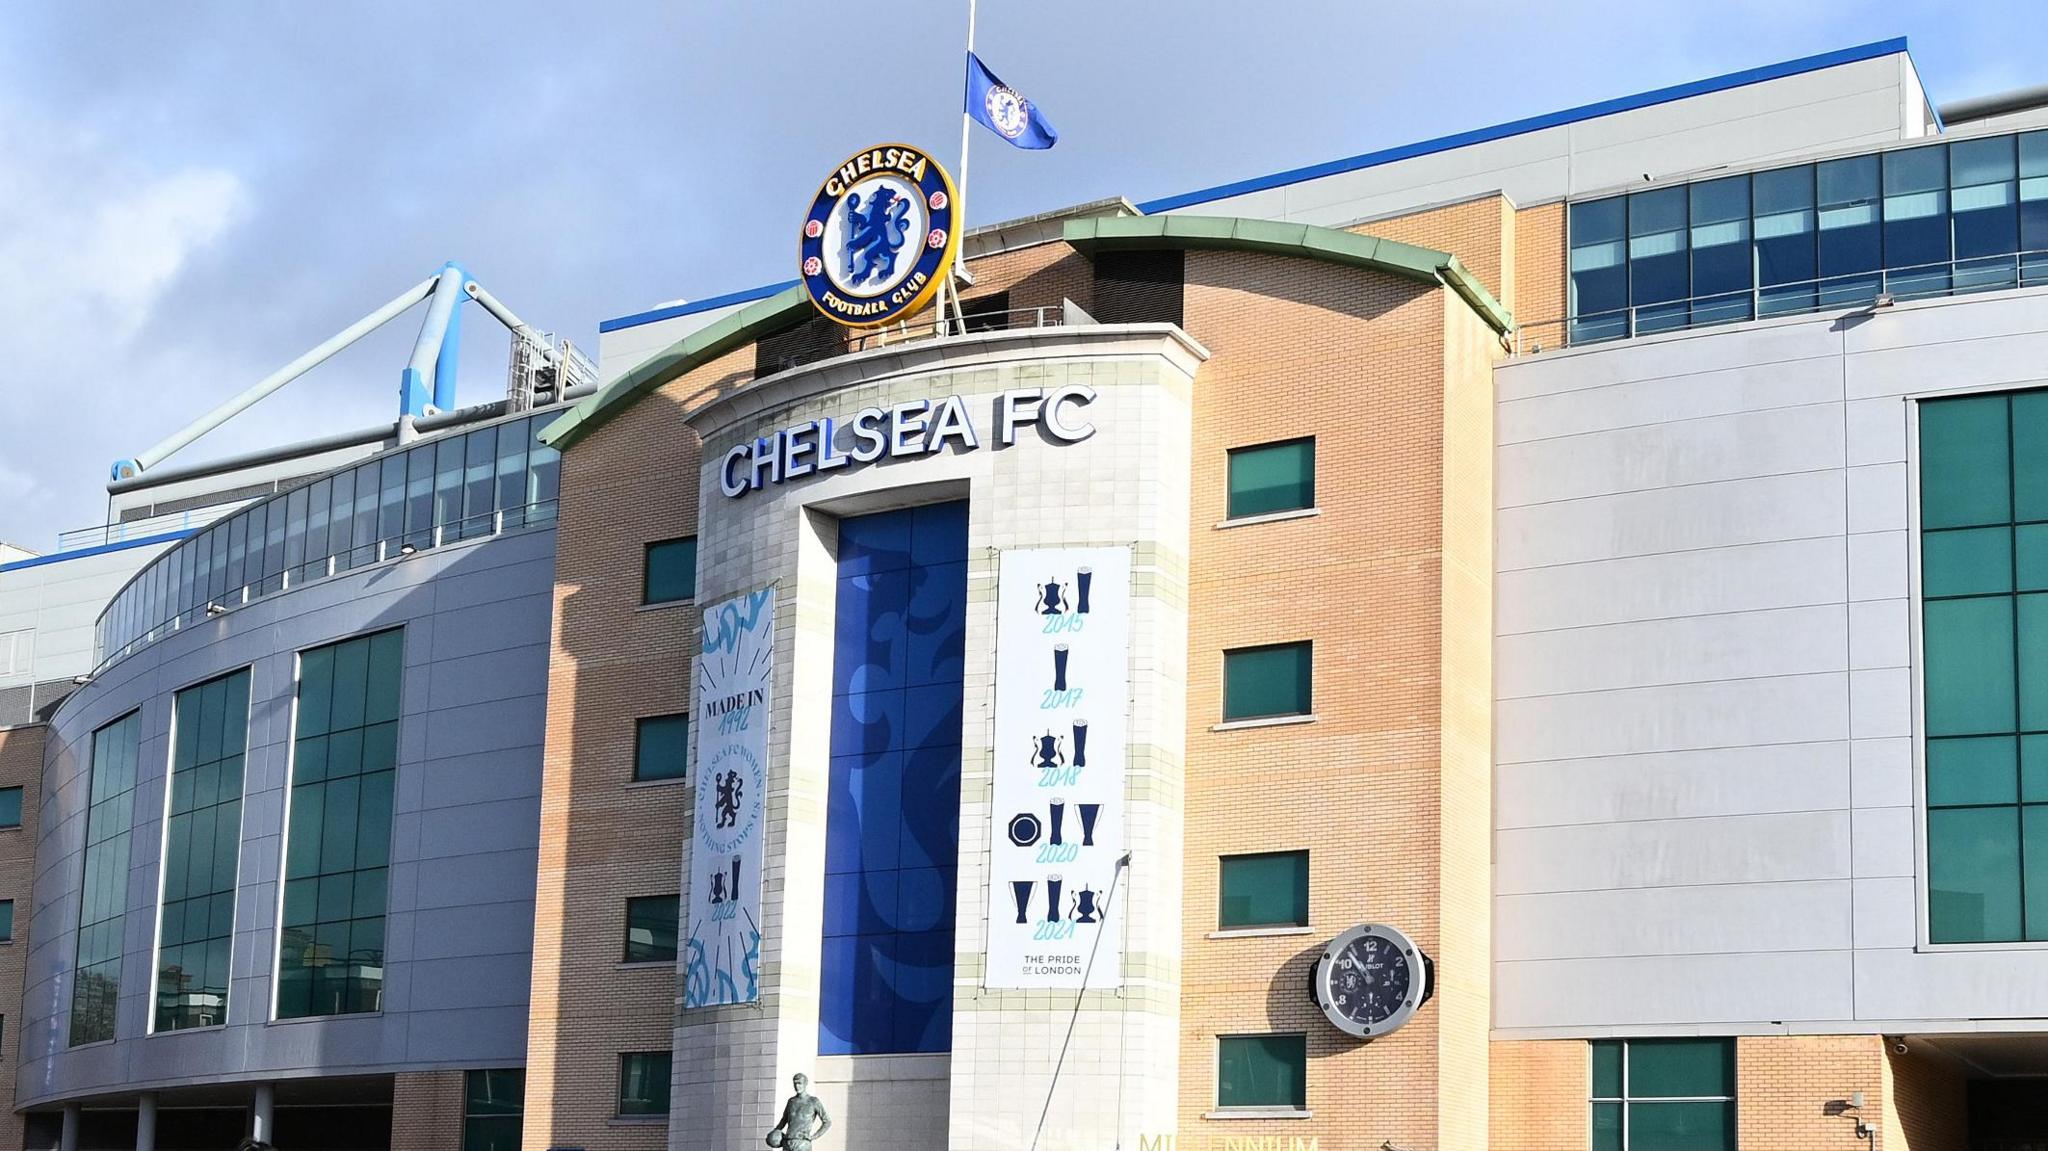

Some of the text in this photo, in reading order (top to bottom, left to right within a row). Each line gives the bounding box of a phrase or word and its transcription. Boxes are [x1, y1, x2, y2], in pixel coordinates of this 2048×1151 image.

[825, 147, 928, 197] CHELSEA
[822, 271, 928, 315] FOOTBALL CLUB
[720, 383, 1098, 498] CHELSEA FC
[1042, 612, 1084, 634] 2015
[705, 687, 765, 719] MADE IN
[1040, 688, 1084, 709] 2017
[718, 707, 751, 737] 1992
[699, 747, 728, 801] CHELSEA
[740, 745, 762, 789] WOMEN
[1038, 766, 1082, 788] 2018
[699, 812, 726, 854] NOTHING
[726, 822, 754, 852] STOPS
[1036, 842, 1079, 864] 2020
[711, 900, 738, 922] 2022
[1033, 918, 1076, 941] 2021
[1363, 940, 1378, 952] 12
[1022, 966, 1082, 975] OF LONDON
[1024, 955, 1081, 964] THE PRIDE
[1340, 958, 1353, 970] 10
[1395, 956, 1404, 968] 2
[1338, 994, 1347, 1006] 8
[1395, 990, 1403, 1001] 4
